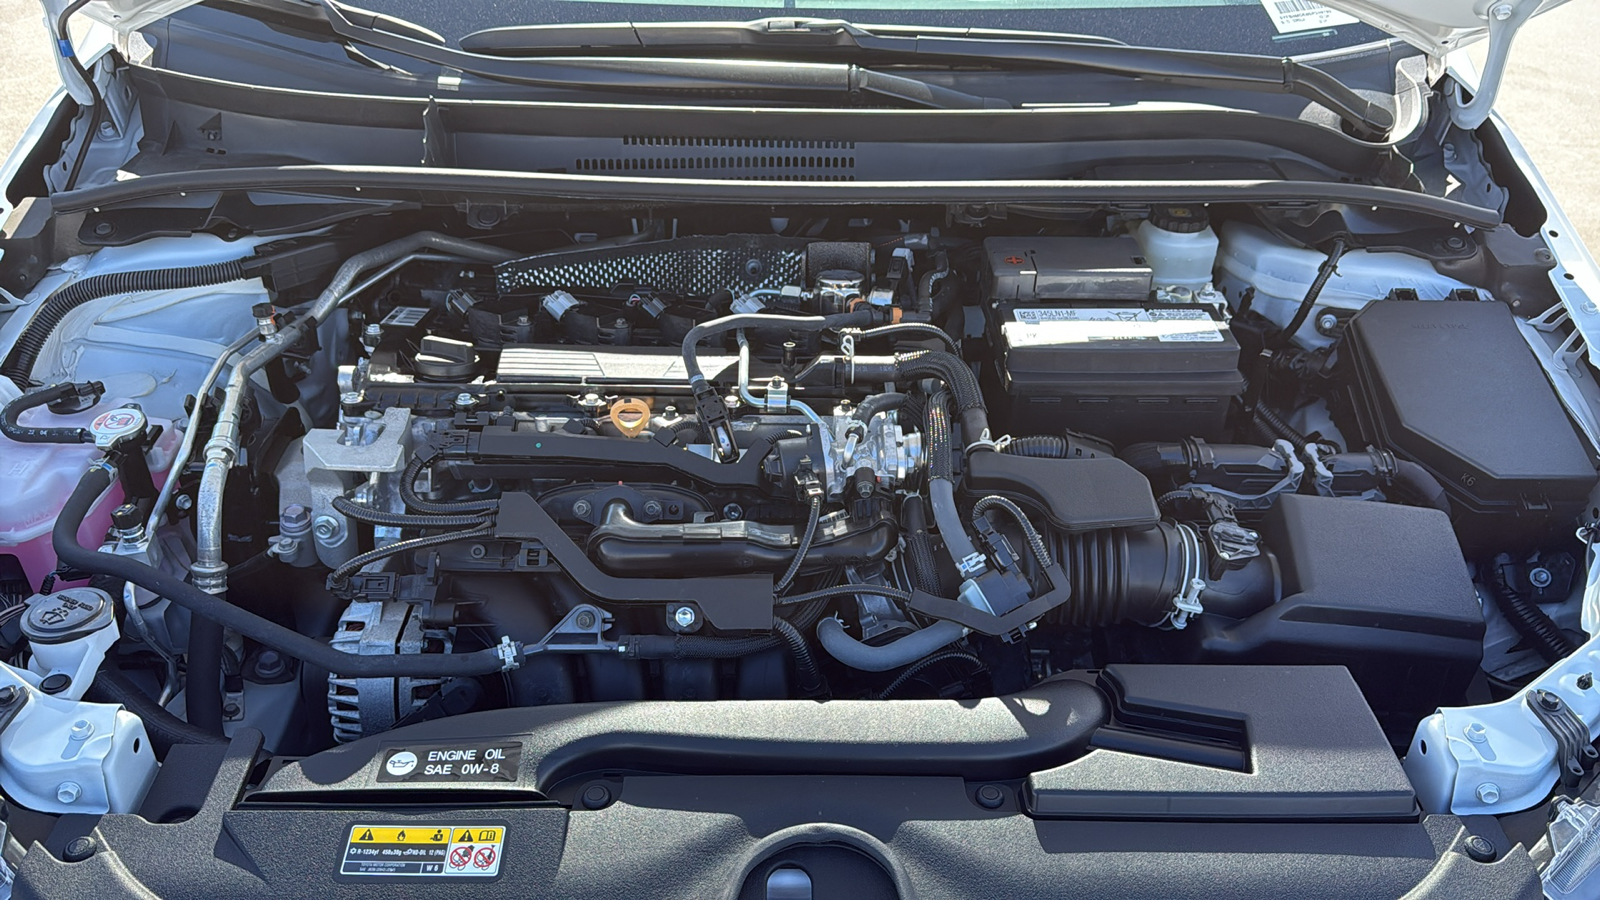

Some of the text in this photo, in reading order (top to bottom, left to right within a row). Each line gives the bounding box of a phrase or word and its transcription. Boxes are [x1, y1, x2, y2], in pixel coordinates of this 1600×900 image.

[427, 748, 506, 762] ENGINE OIL
[424, 763, 500, 775] SAE 0W-8
